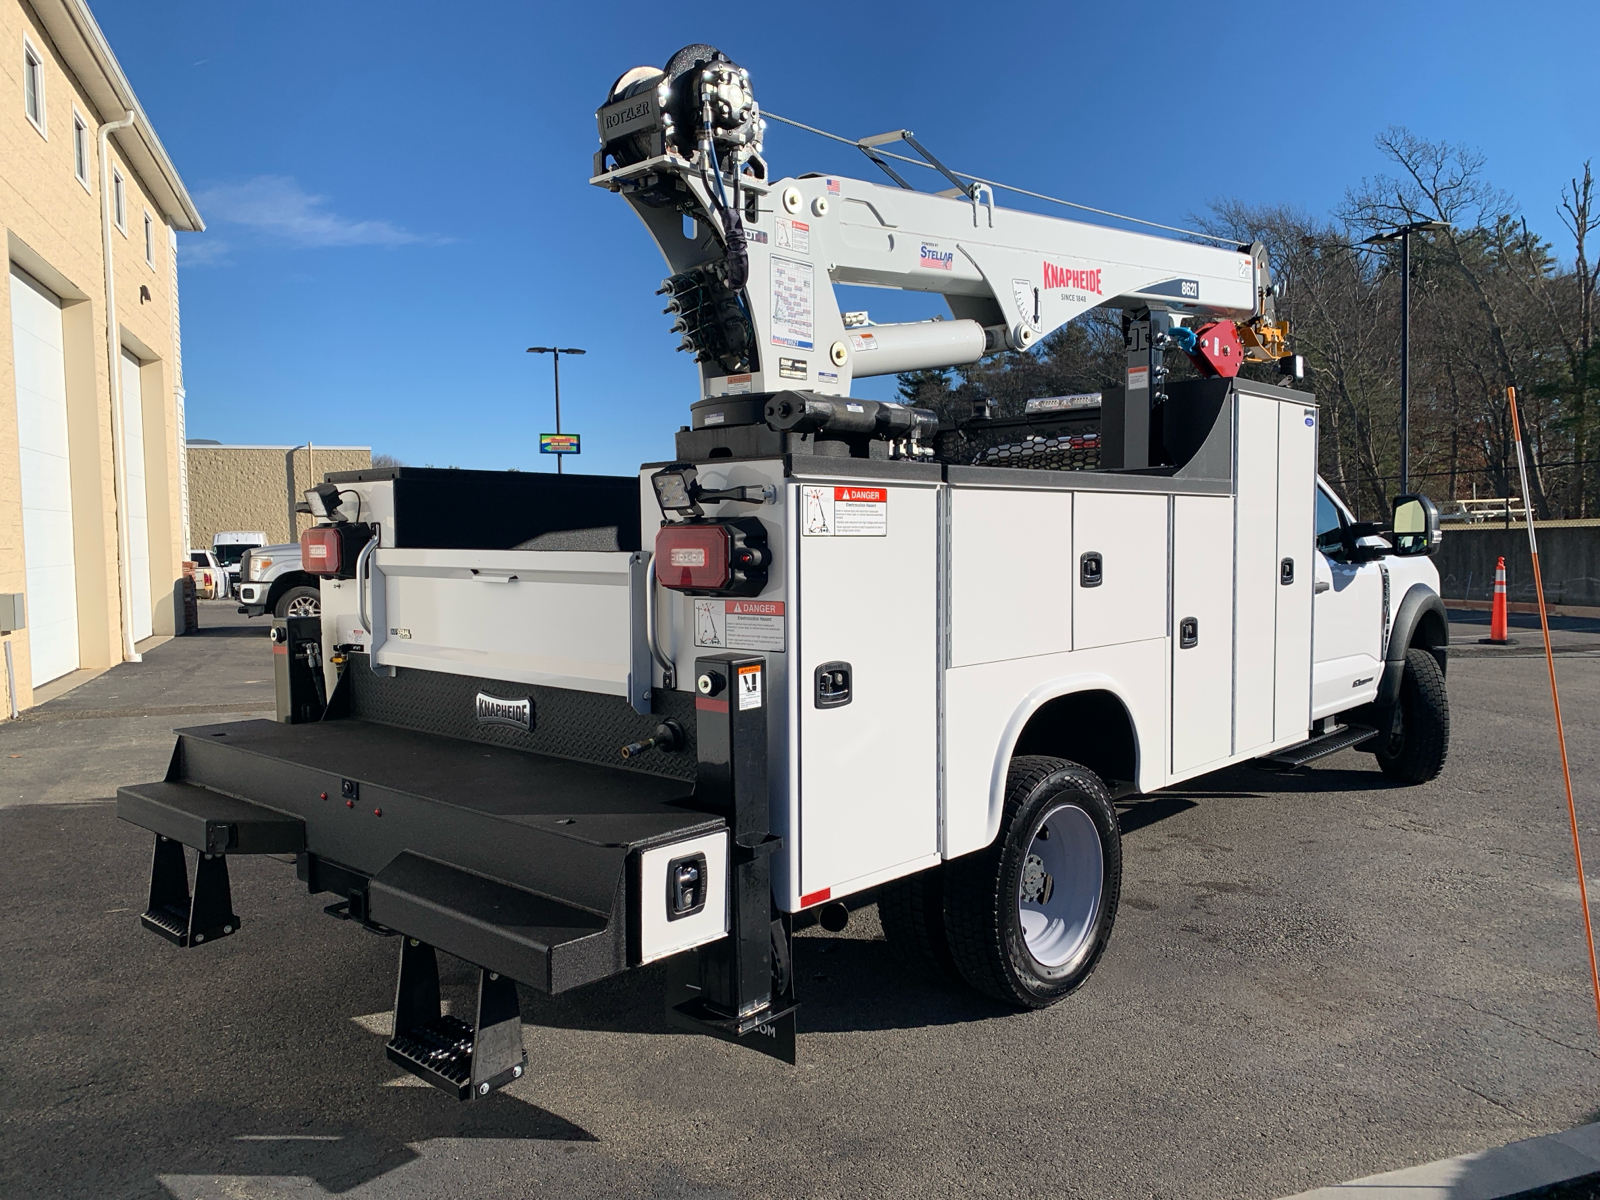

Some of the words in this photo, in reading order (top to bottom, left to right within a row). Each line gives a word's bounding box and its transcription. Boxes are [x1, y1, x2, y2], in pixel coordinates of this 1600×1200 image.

[606, 101, 650, 129] ROTZLER
[743, 229, 759, 241] DT
[921, 246, 953, 262] STELLAR
[1043, 260, 1102, 296] KNAPHEIDE
[1181, 281, 1197, 296] 8621
[1061, 293, 1075, 302] SINCE
[1076, 295, 1087, 303] 1848
[851, 490, 880, 500] DANGER
[743, 604, 776, 613] DANGER
[479, 698, 528, 726] KNAPHEIDE
